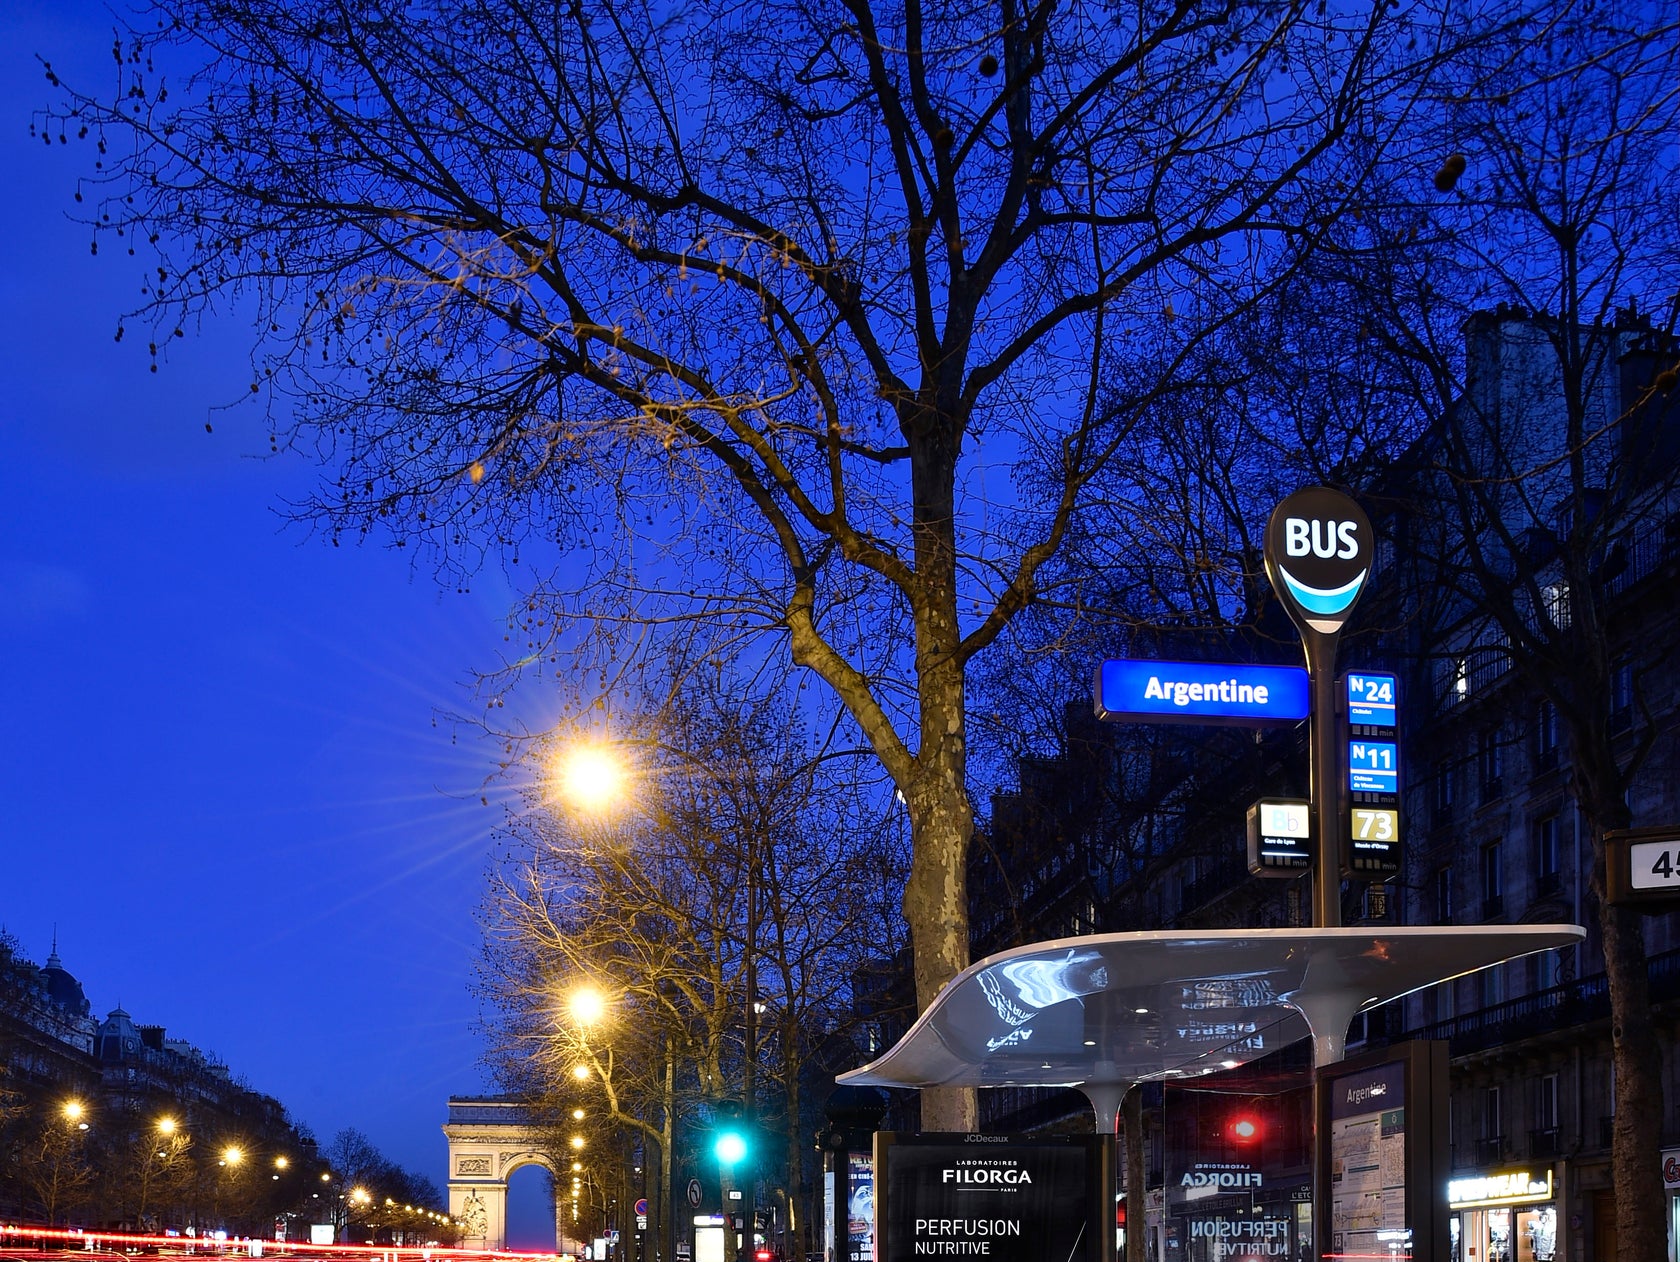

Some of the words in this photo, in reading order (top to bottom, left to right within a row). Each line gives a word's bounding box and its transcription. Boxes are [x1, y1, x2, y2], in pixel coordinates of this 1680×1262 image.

[1286, 518, 1359, 560] BUS
[1144, 676, 1269, 706] Argentine
[1356, 811, 1393, 840] 73
[1651, 850, 1680, 879] 4
[964, 1134, 1009, 1143] JCDecaux
[942, 1169, 1033, 1184] FILORGA
[915, 1219, 1020, 1236] PERFUSION
[850, 1252, 859, 1261] 13
[915, 1241, 990, 1255] NUTRITIVE
